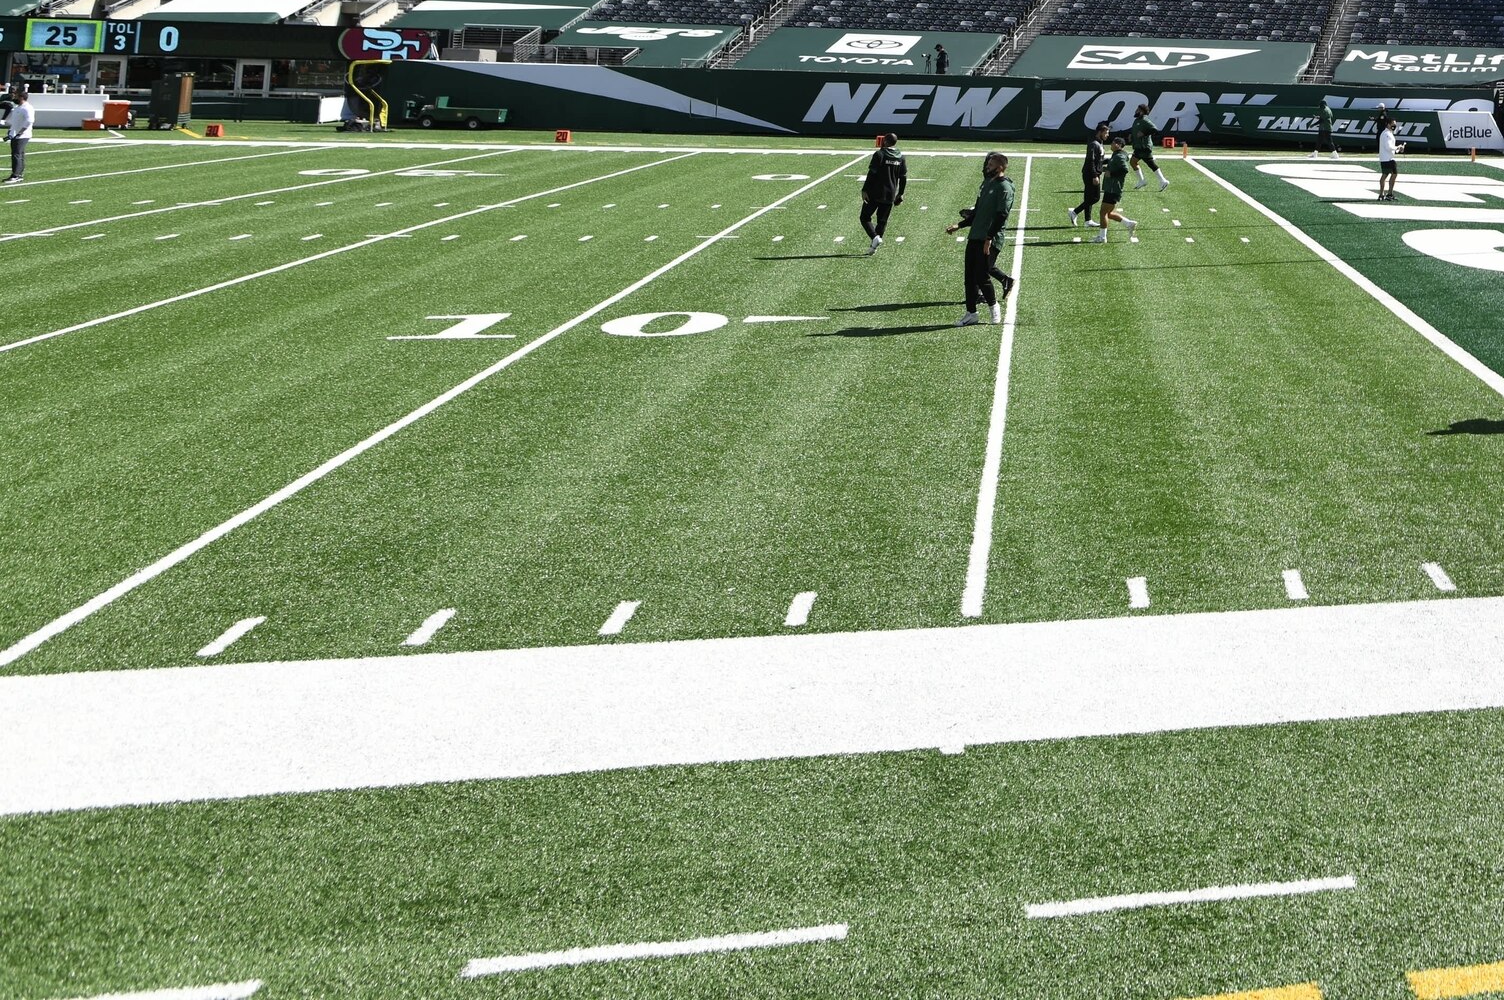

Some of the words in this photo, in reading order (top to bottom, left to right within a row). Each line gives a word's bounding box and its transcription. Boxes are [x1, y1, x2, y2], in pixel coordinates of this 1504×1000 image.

[45, 26, 78, 46] 25
[108, 22, 134, 34] TOL
[576, 26, 724, 37] JETS
[114, 35, 126, 50] 3
[159, 26, 180, 51] 0
[798, 55, 914, 66] TOYOTA
[1076, 50, 1210, 66] SAP
[1371, 63, 1497, 72] Stadium
[802, 82, 1023, 129] NEW
[1333, 118, 1431, 136] FLIHT
[1448, 124, 1493, 141] jetBlue
[555, 130, 569, 142] 20
[386, 311, 731, 340] 10
